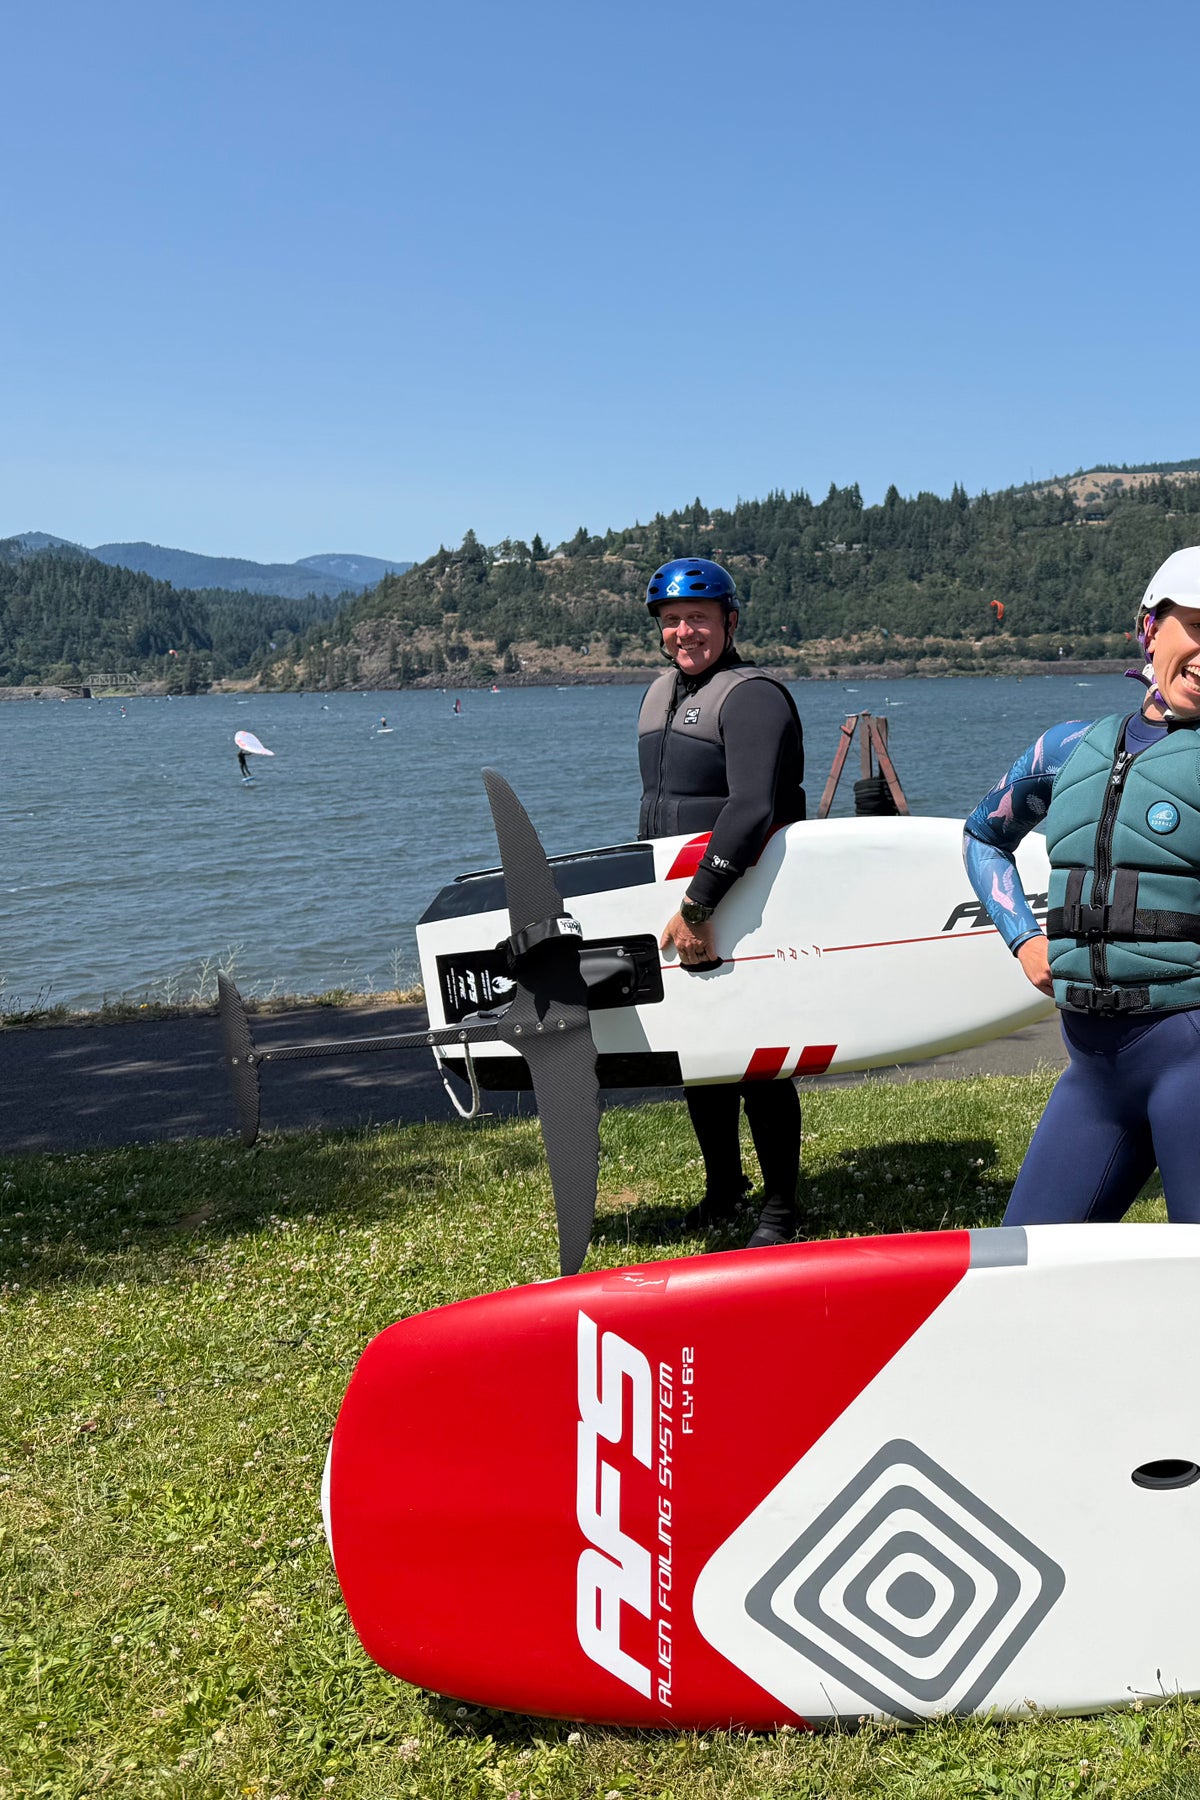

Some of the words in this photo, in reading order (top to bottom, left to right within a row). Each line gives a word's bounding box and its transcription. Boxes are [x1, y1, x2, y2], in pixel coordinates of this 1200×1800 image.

[681, 1346, 694, 1385] 6'2
[681, 1390, 694, 1434] FLY
[657, 1361, 673, 1490] SYSTEM
[576, 1308, 652, 1700] AFS
[657, 1495, 673, 1613] FOILING
[657, 1620, 673, 1708] ALIEN
